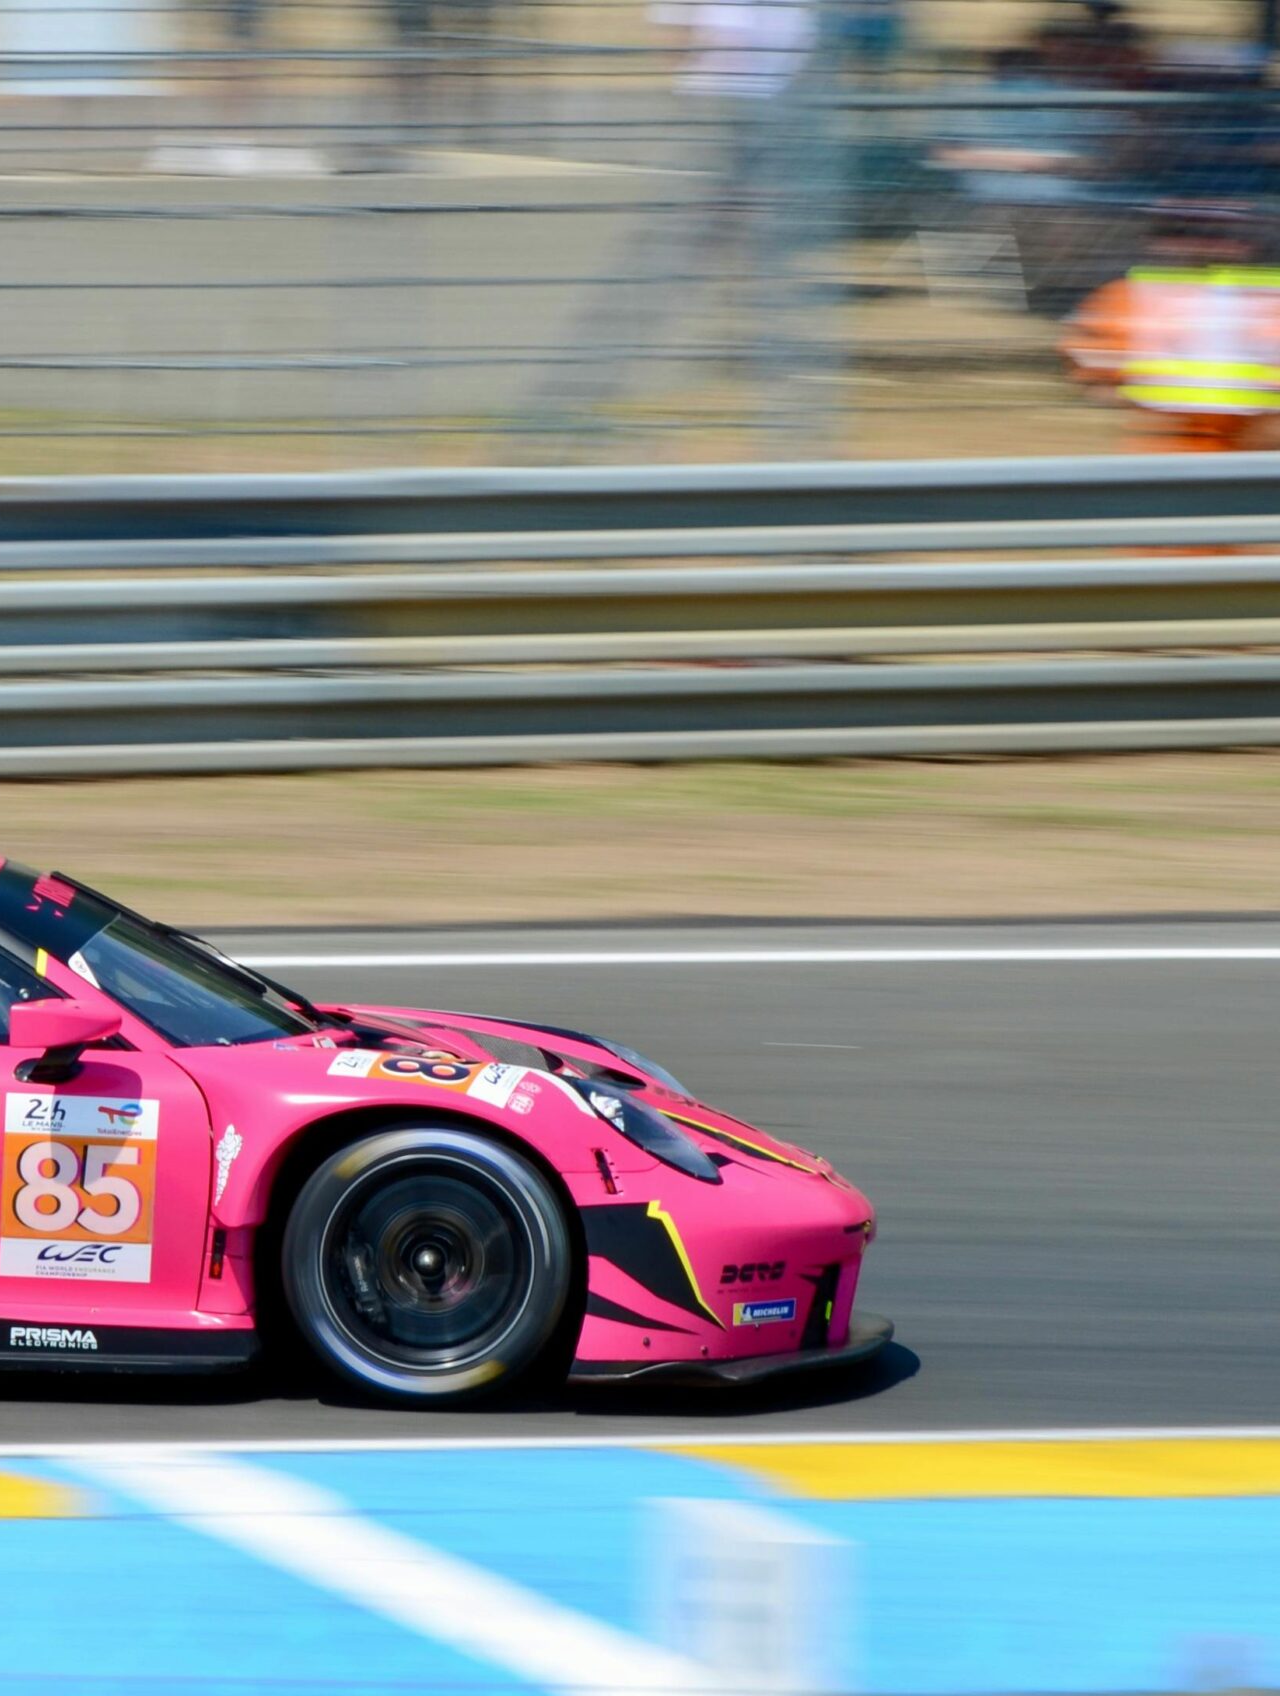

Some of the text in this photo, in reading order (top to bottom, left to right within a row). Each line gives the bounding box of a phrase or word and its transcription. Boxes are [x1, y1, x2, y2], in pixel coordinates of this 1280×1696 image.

[35, 1121, 63, 1129] MANS
[13, 1141, 141, 1235] 85
[37, 1243, 123, 1264] WEC
[753, 1306, 789, 1317] MICHELIN
[10, 1326, 97, 1343] PRISMA
[10, 1340, 98, 1350] ELECTRONICS
